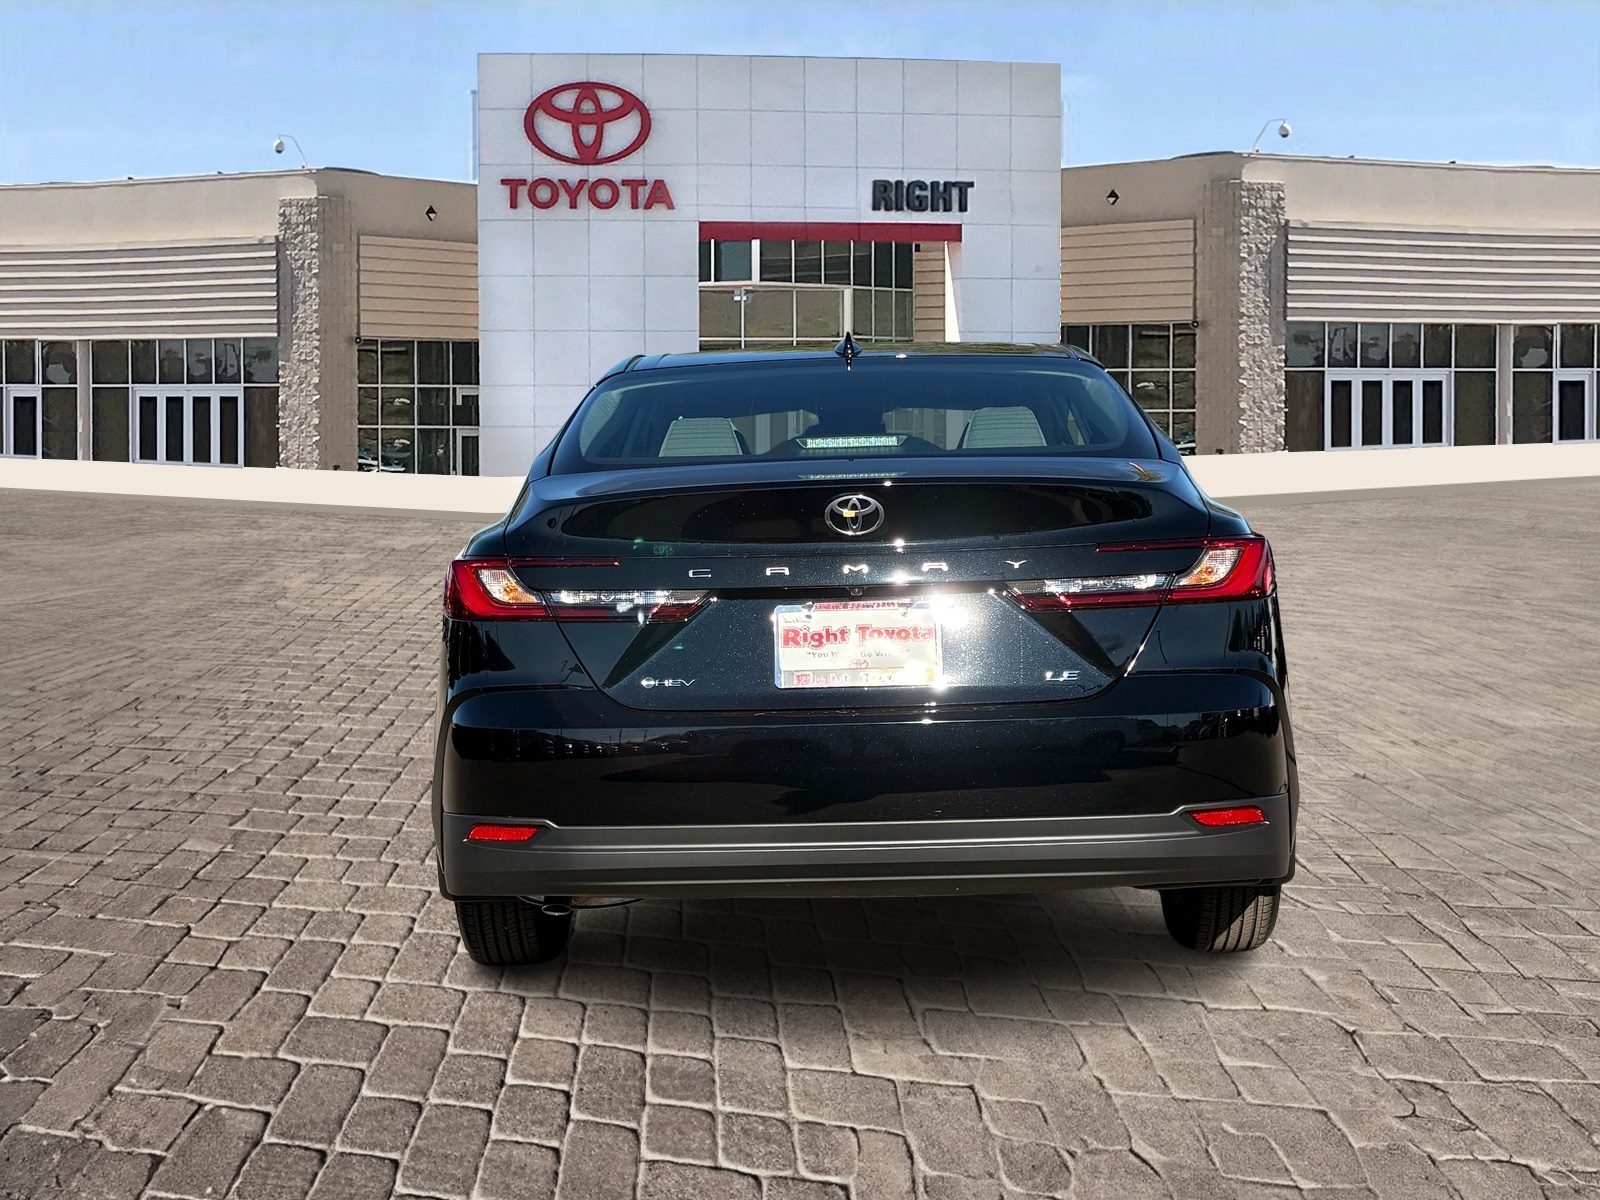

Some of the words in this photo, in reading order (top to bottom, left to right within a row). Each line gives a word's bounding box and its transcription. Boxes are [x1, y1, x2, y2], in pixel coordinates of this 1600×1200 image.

[500, 178, 675, 209] TOYOTA
[871, 180, 975, 212] RIGHT
[781, 626, 849, 649] Right
[655, 679, 697, 687] HEV
[1044, 670, 1080, 681] LE
